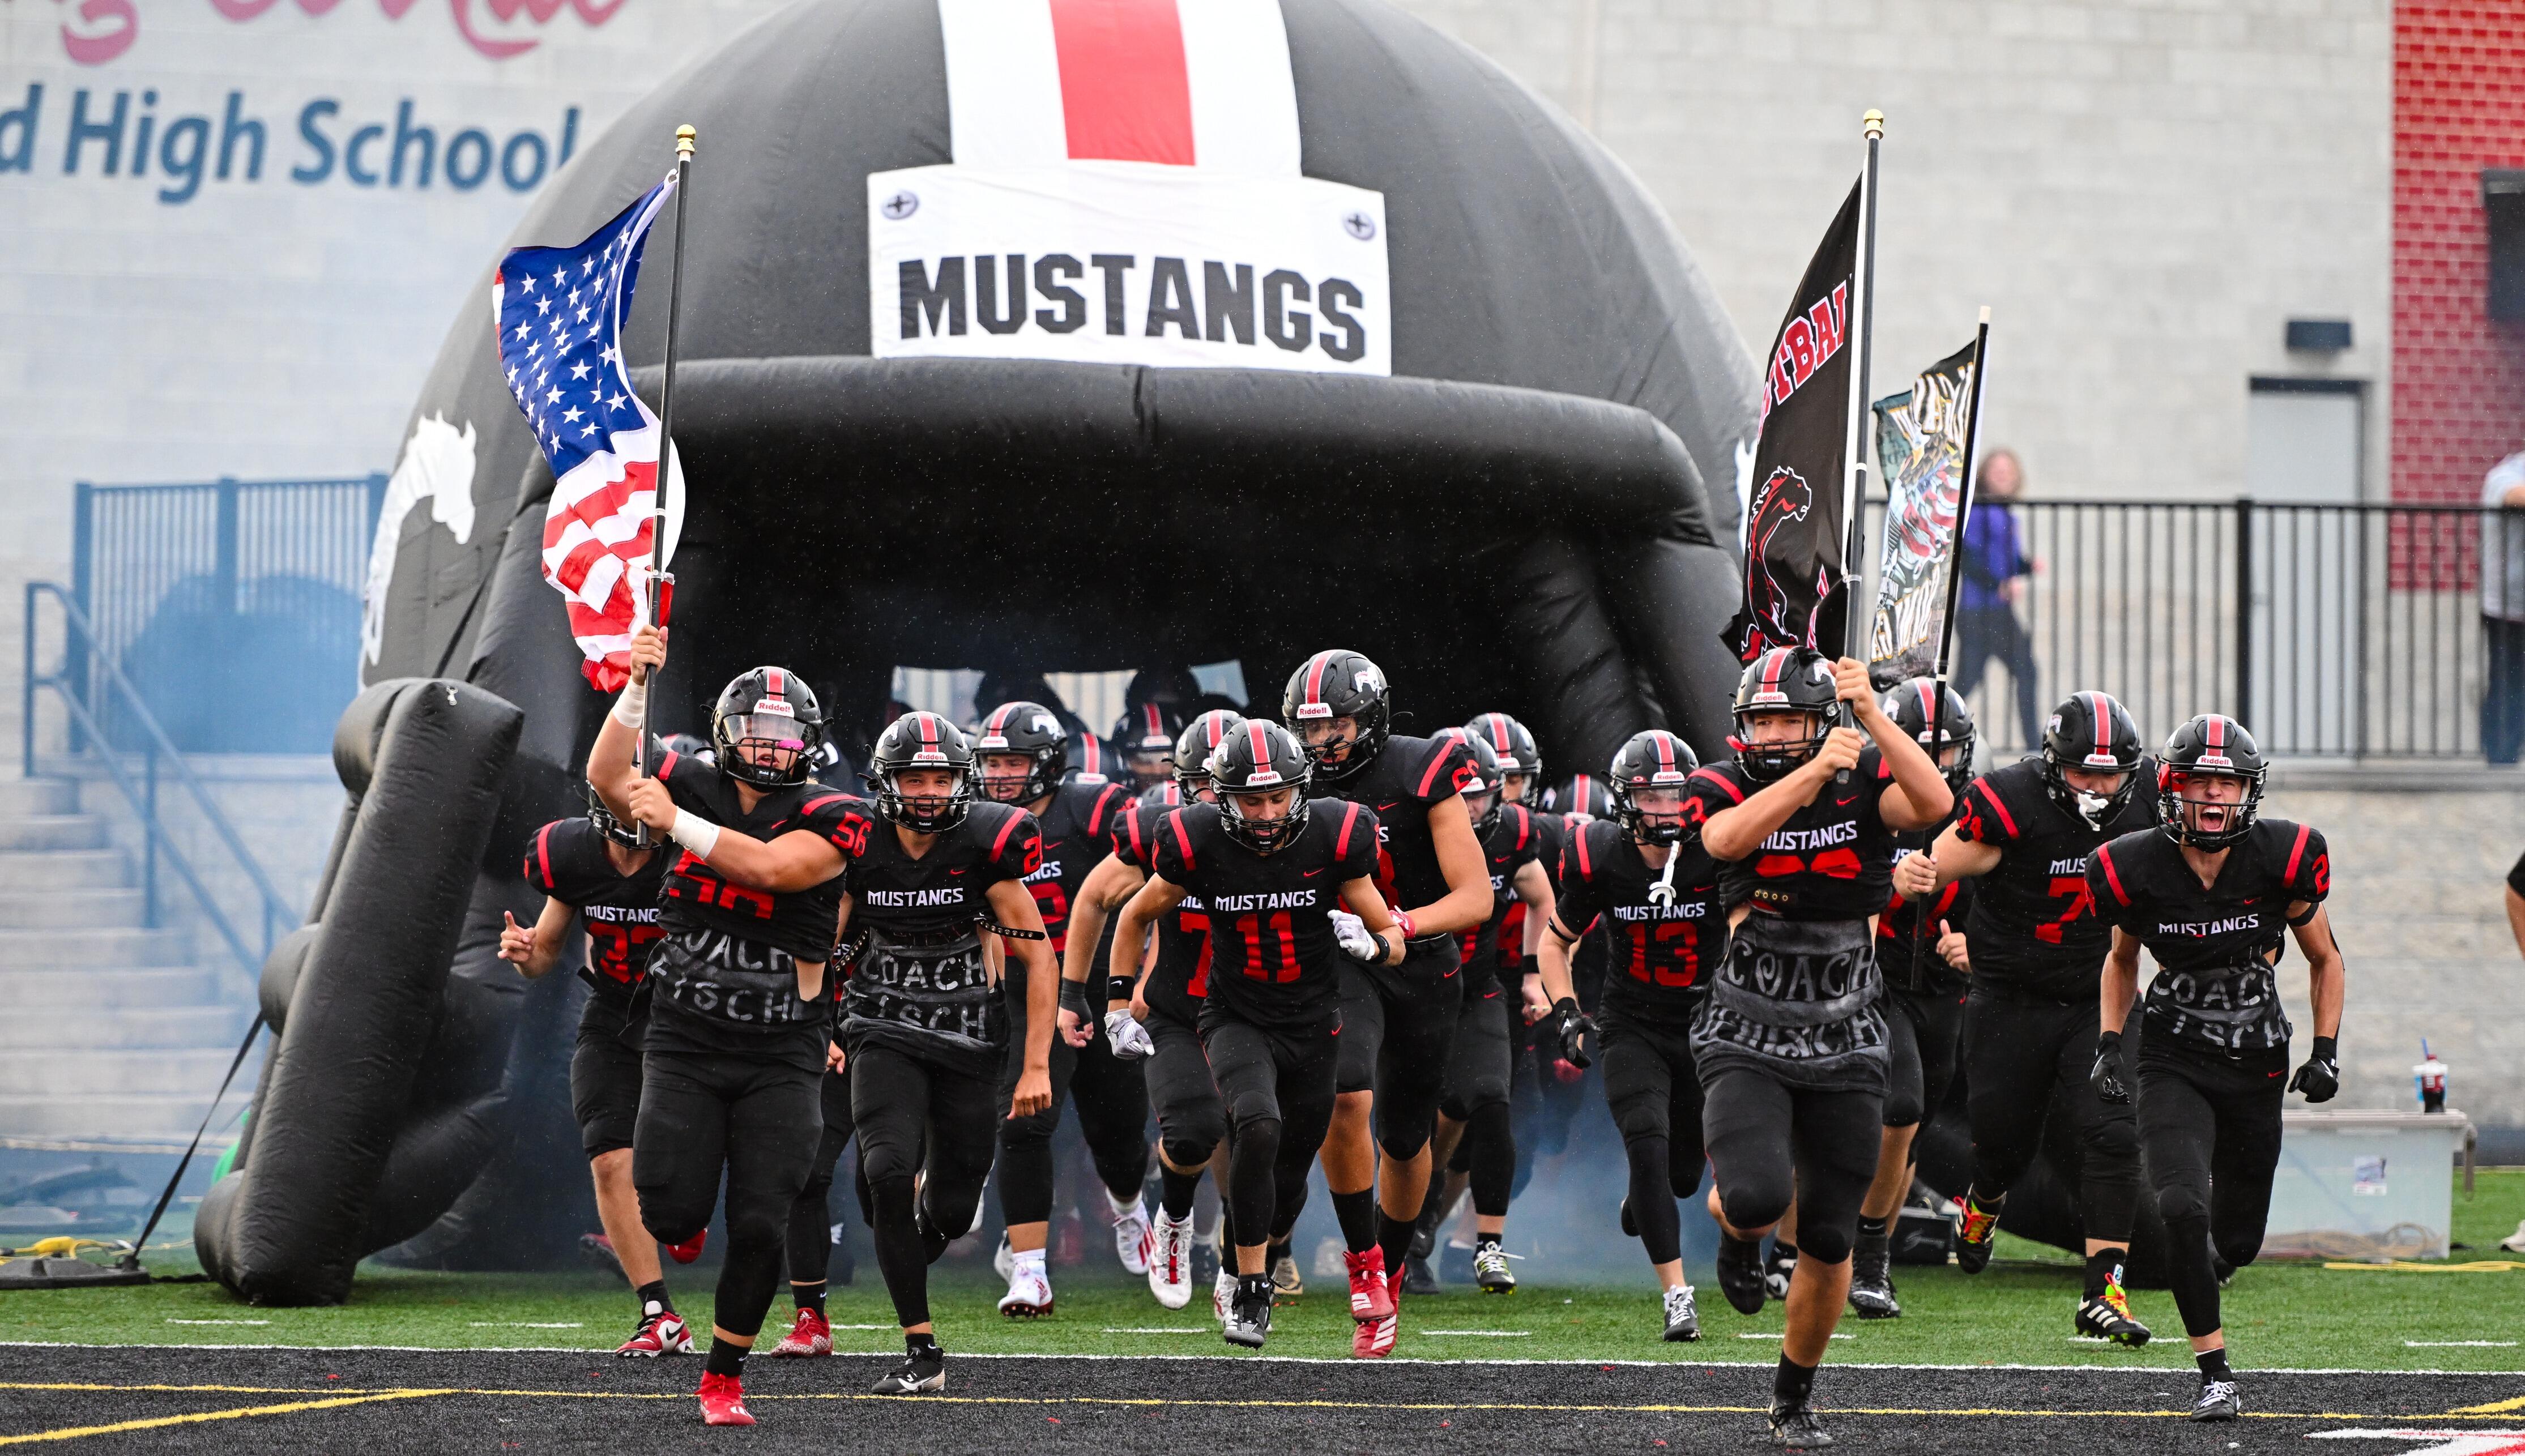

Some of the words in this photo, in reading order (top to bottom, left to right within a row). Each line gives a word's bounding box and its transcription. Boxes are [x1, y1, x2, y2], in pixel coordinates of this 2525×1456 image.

[63, 89, 266, 204] High
[291, 100, 582, 193] School
[899, 254, 1366, 362] MUSTANGS
[759, 702, 791, 712] Riddell
[1251, 774, 1277, 782] Riddell
[831, 811, 872, 857] 56
[868, 887, 963, 907] MUSTANGS
[1215, 889, 1316, 911] MUSTANGS
[1614, 902, 1706, 920] MUSTANGS
[1236, 910, 1301, 983] 11
[1625, 921, 1698, 987] 13
[1727, 940, 1875, 1002] COACH
